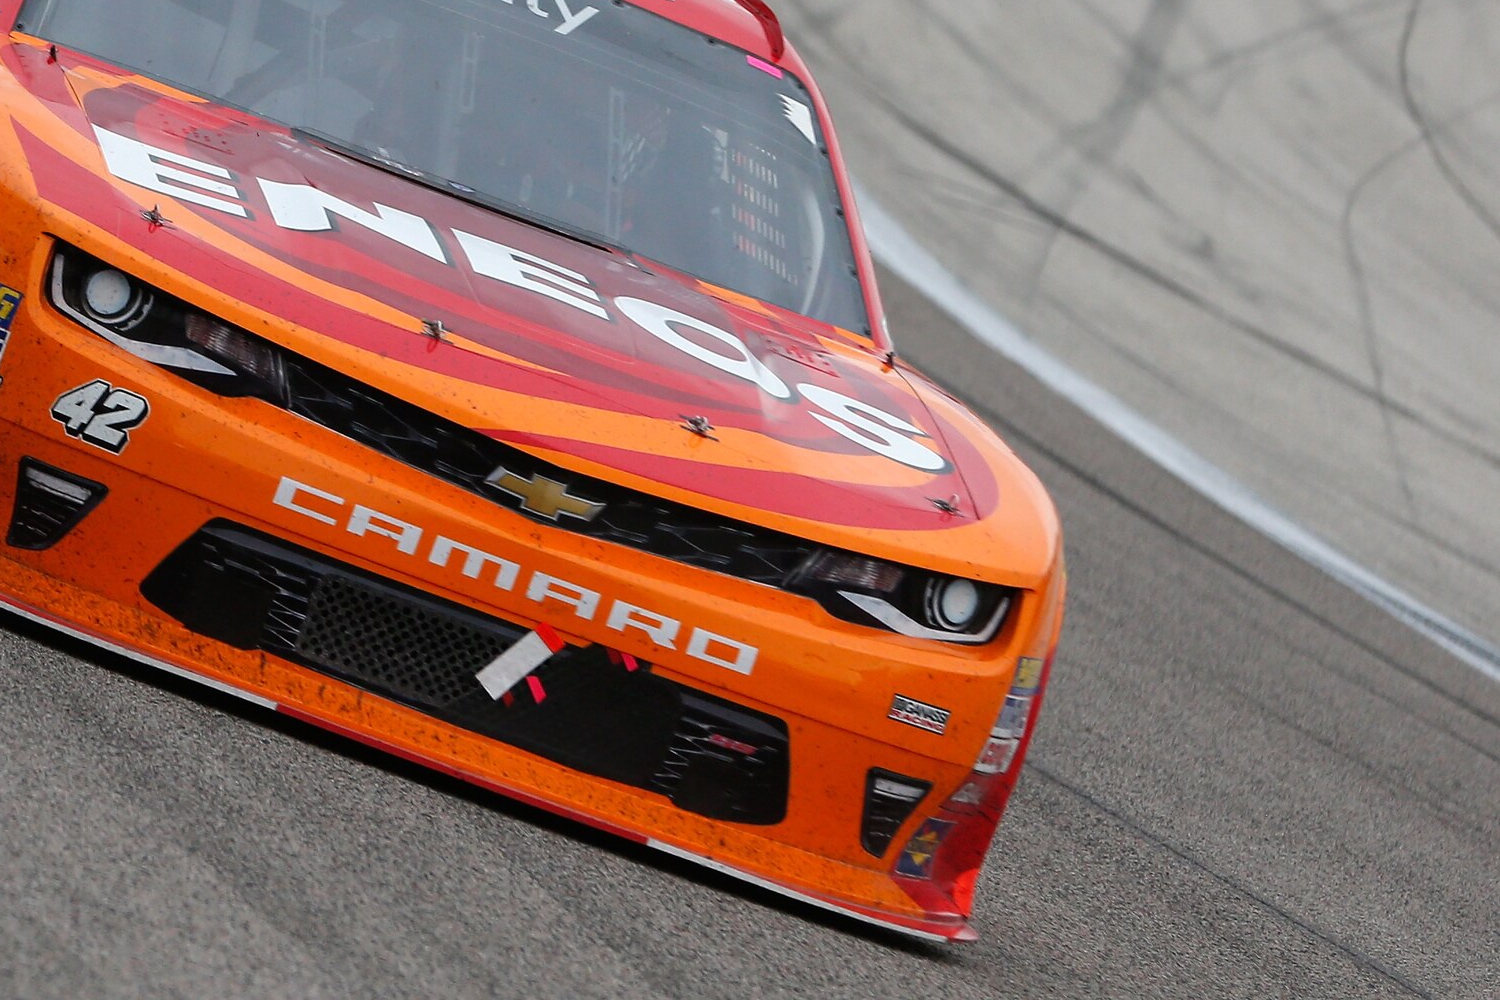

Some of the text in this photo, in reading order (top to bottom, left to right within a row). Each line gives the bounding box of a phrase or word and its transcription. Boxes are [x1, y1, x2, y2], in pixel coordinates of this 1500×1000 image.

[92, 123, 948, 477] ENEOS
[49, 378, 151, 456] 42
[272, 476, 758, 676] CAMARO
